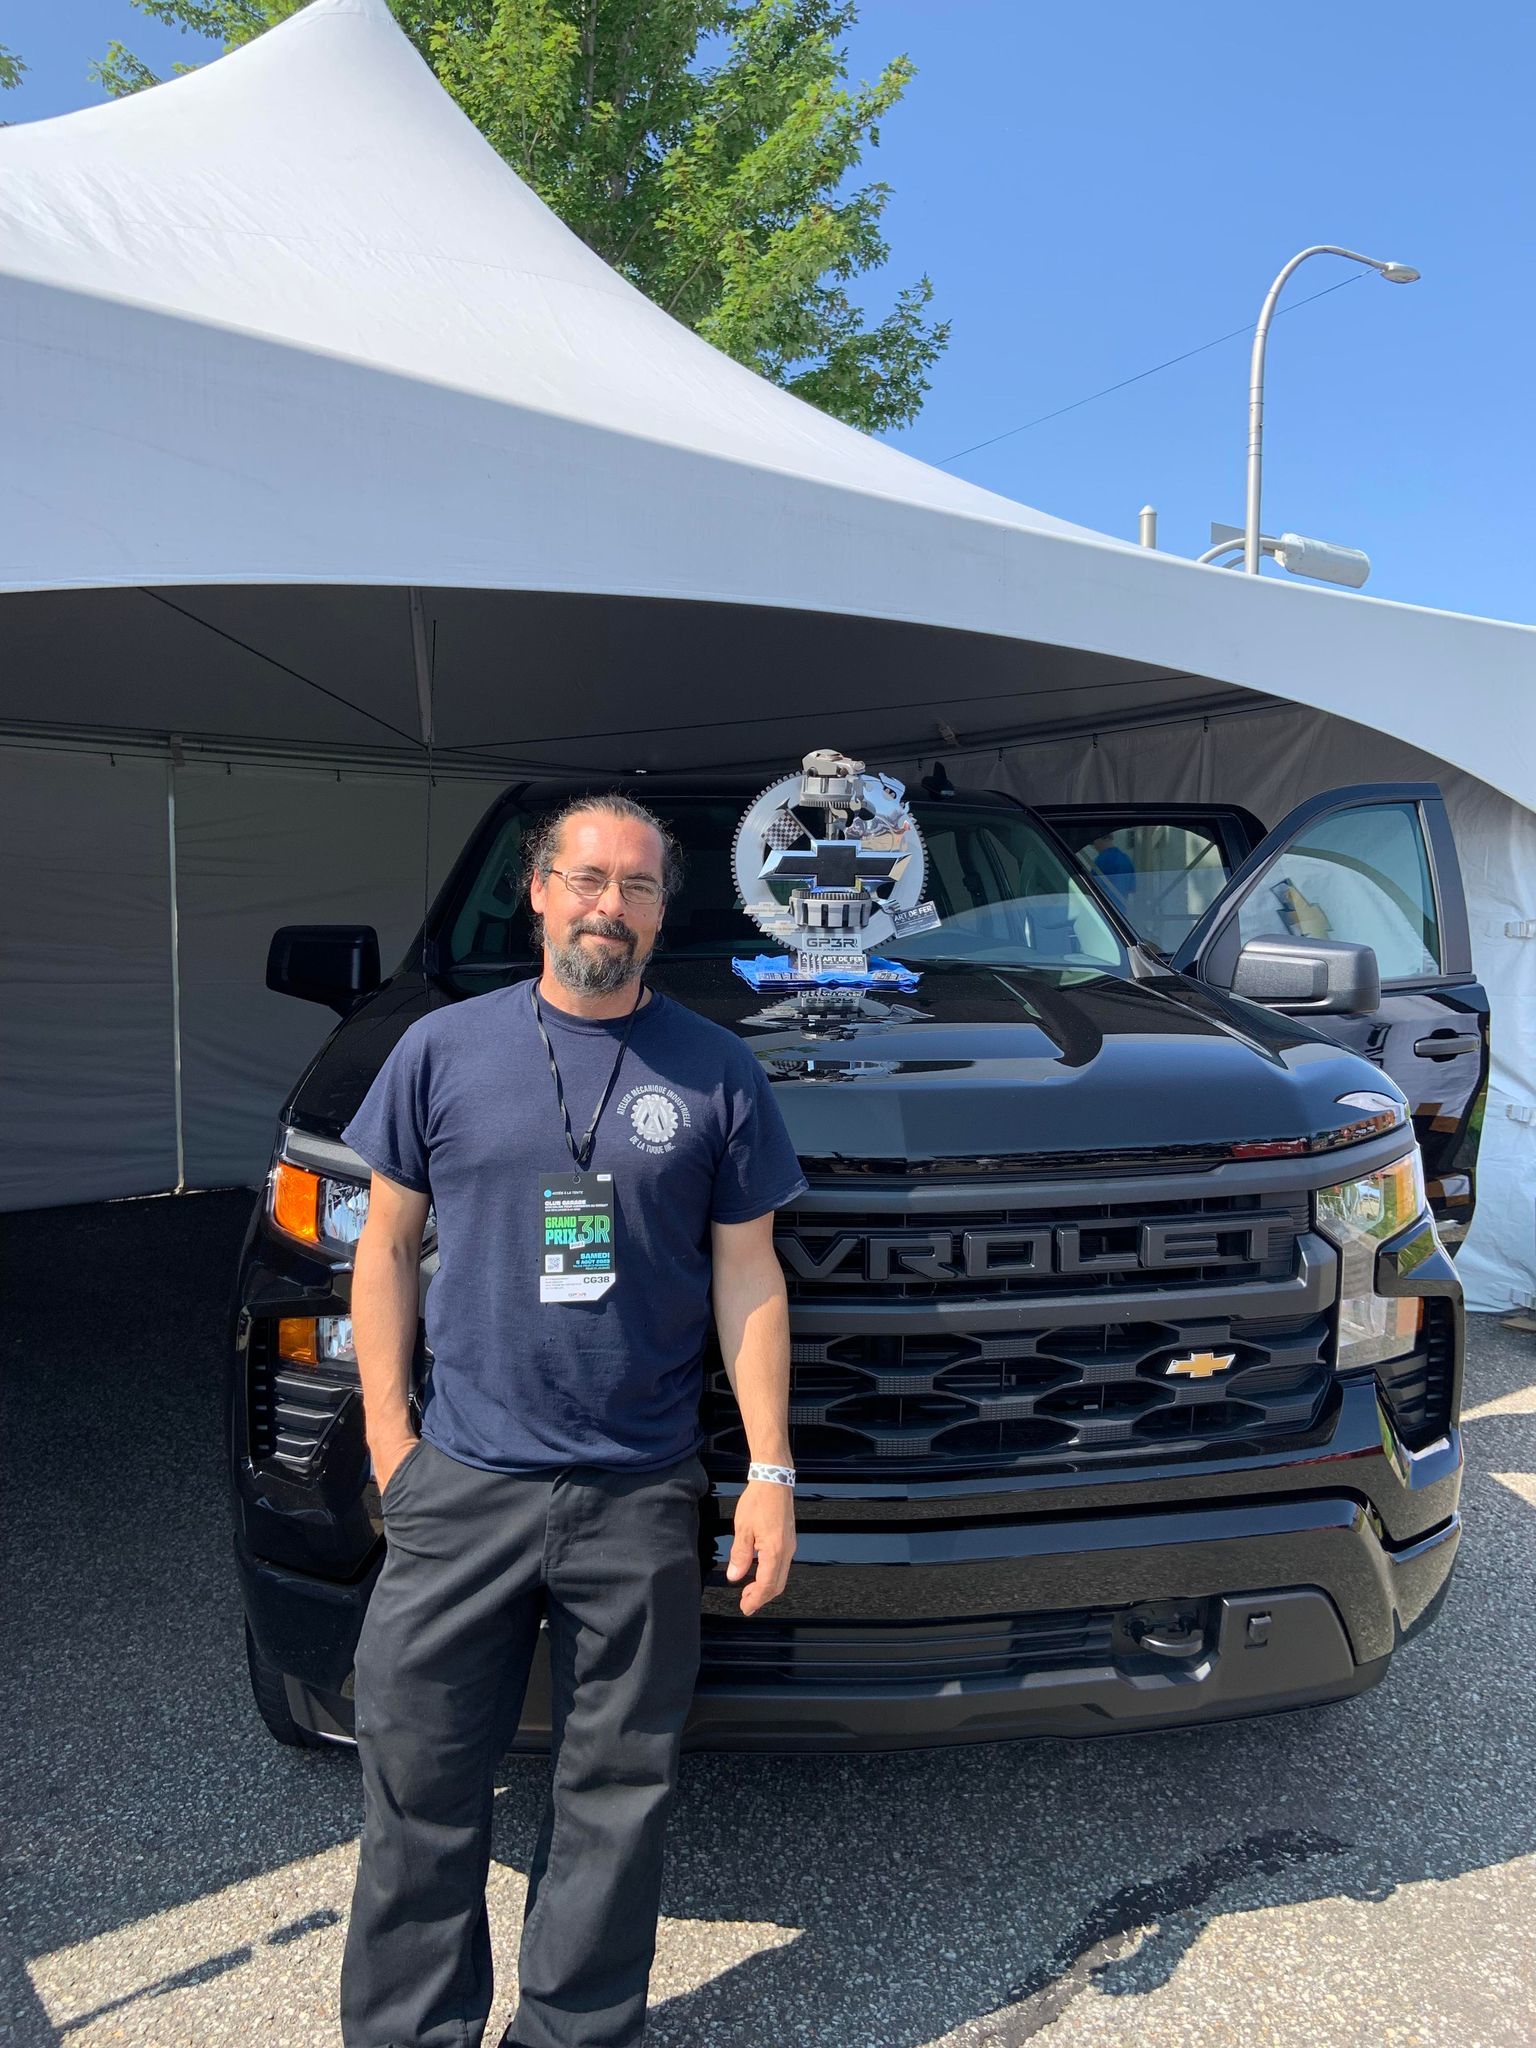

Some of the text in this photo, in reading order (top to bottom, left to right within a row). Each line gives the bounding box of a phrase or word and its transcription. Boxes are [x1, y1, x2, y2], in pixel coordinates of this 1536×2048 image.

[894, 905, 933, 922] ART DE FER
[616, 1084, 691, 1128] ATELIER MÉCANIQUE INDUSTRIELLE
[630, 1136, 638, 1144] DE
[637, 1140, 645, 1150] LA
[646, 1144, 664, 1154] TUQUE
[545, 1215, 610, 1244] GRAND 3R
[545, 1229, 577, 1245] PRIX
[583, 1276, 610, 1284] CG38
